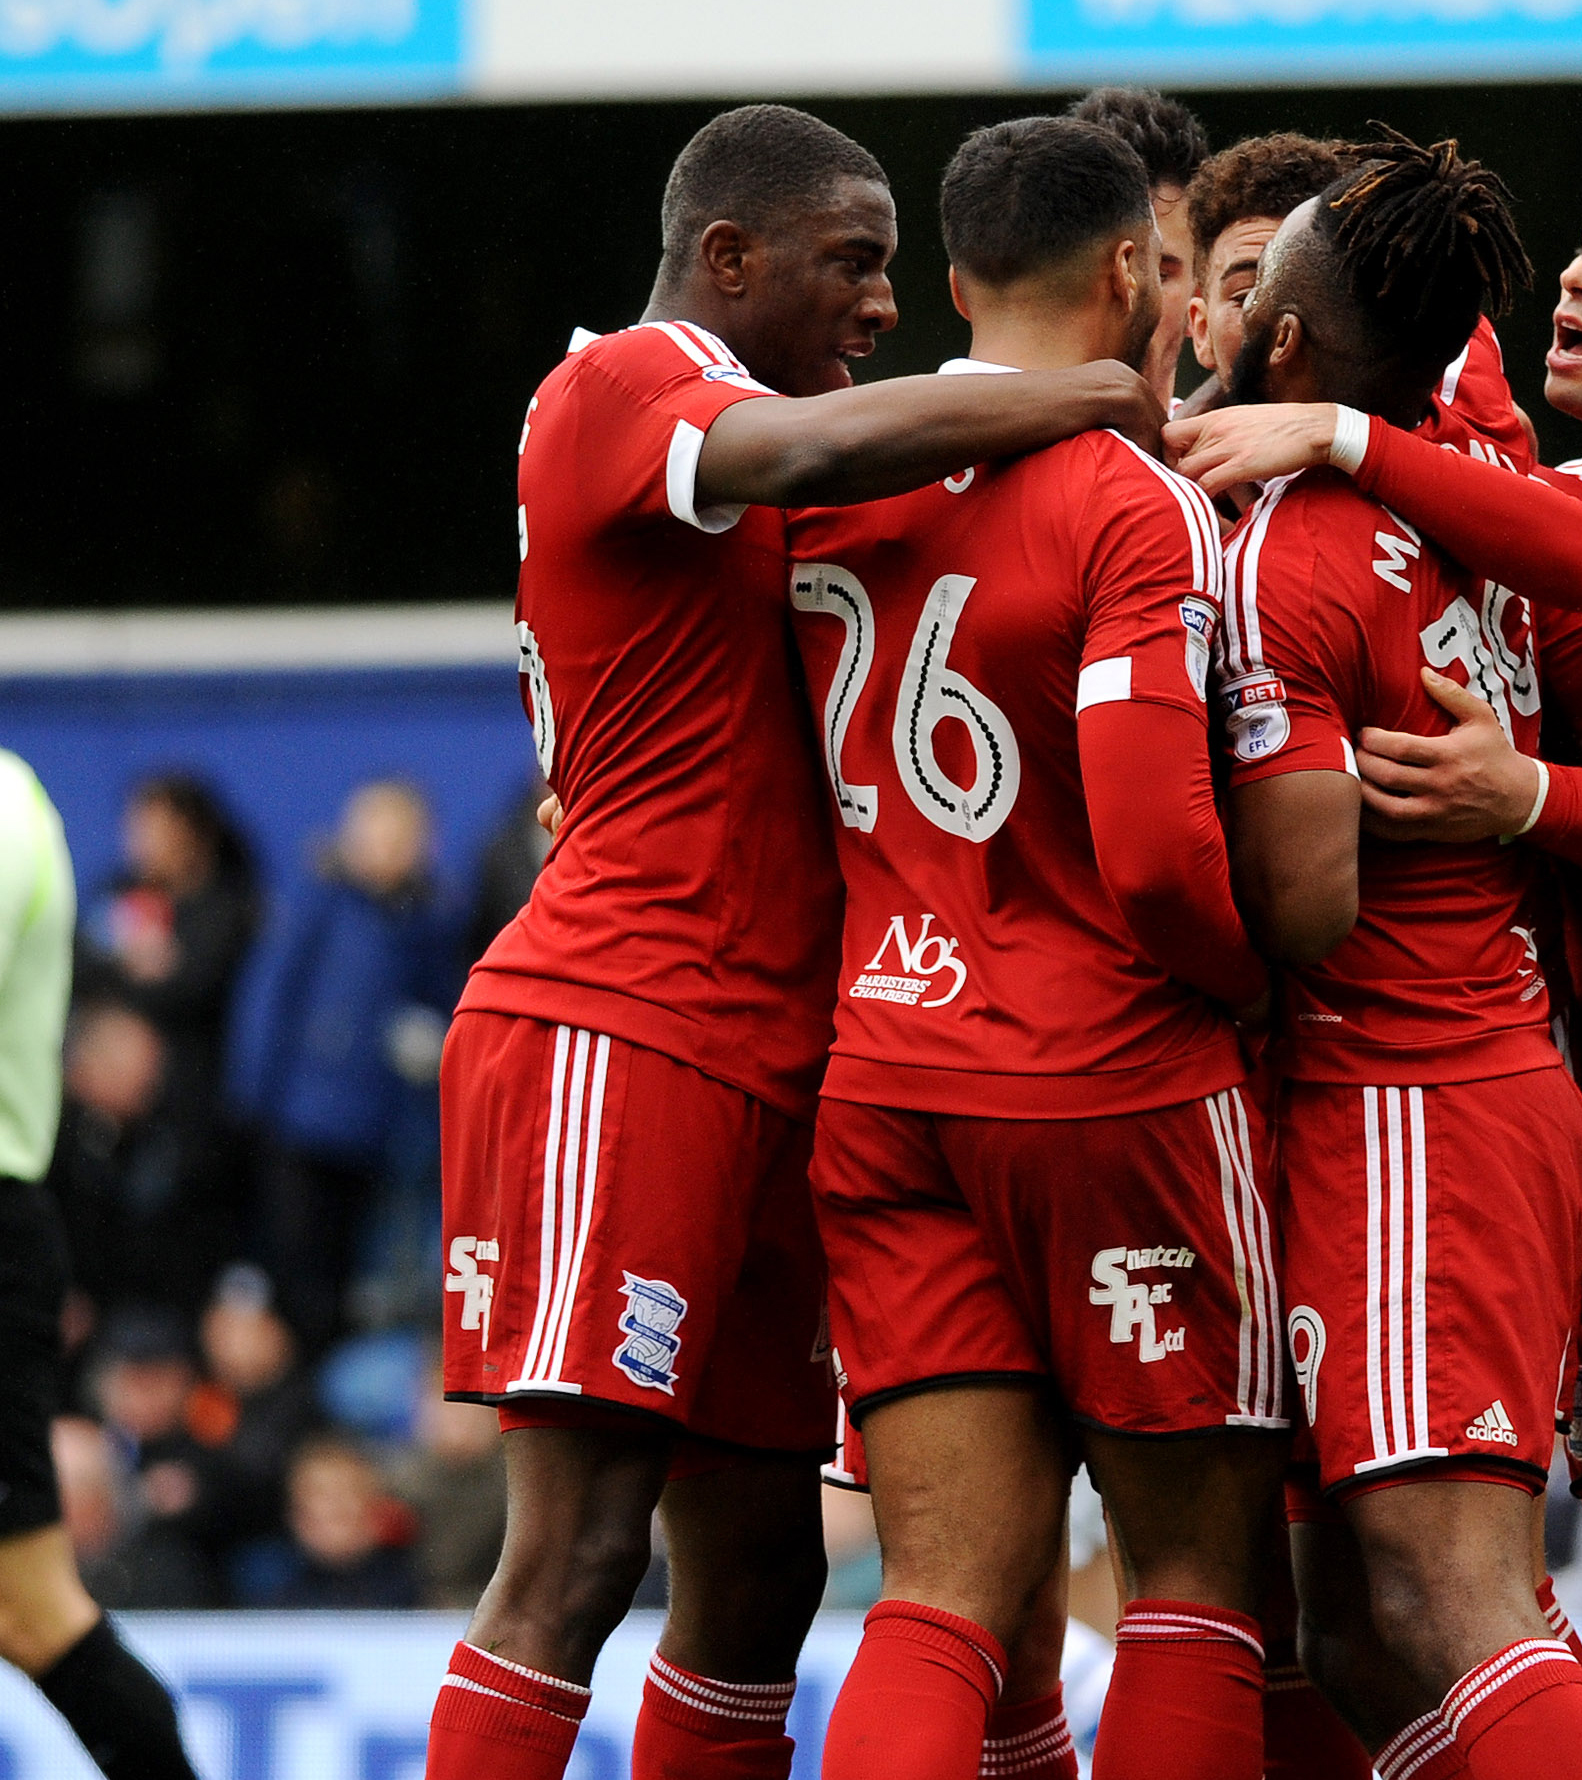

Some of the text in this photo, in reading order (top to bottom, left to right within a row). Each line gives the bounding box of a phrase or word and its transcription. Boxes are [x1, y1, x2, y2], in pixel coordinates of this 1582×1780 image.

[1183, 609, 1207, 632] sky
[791, 562, 1021, 844] 26
[1244, 682, 1278, 704] BET
[1248, 738, 1270, 754] EFL
[848, 985, 920, 1006] CHAMBERS
[1089, 1245, 1197, 1305] Snatch
[1465, 1425, 1518, 1447] adidas
